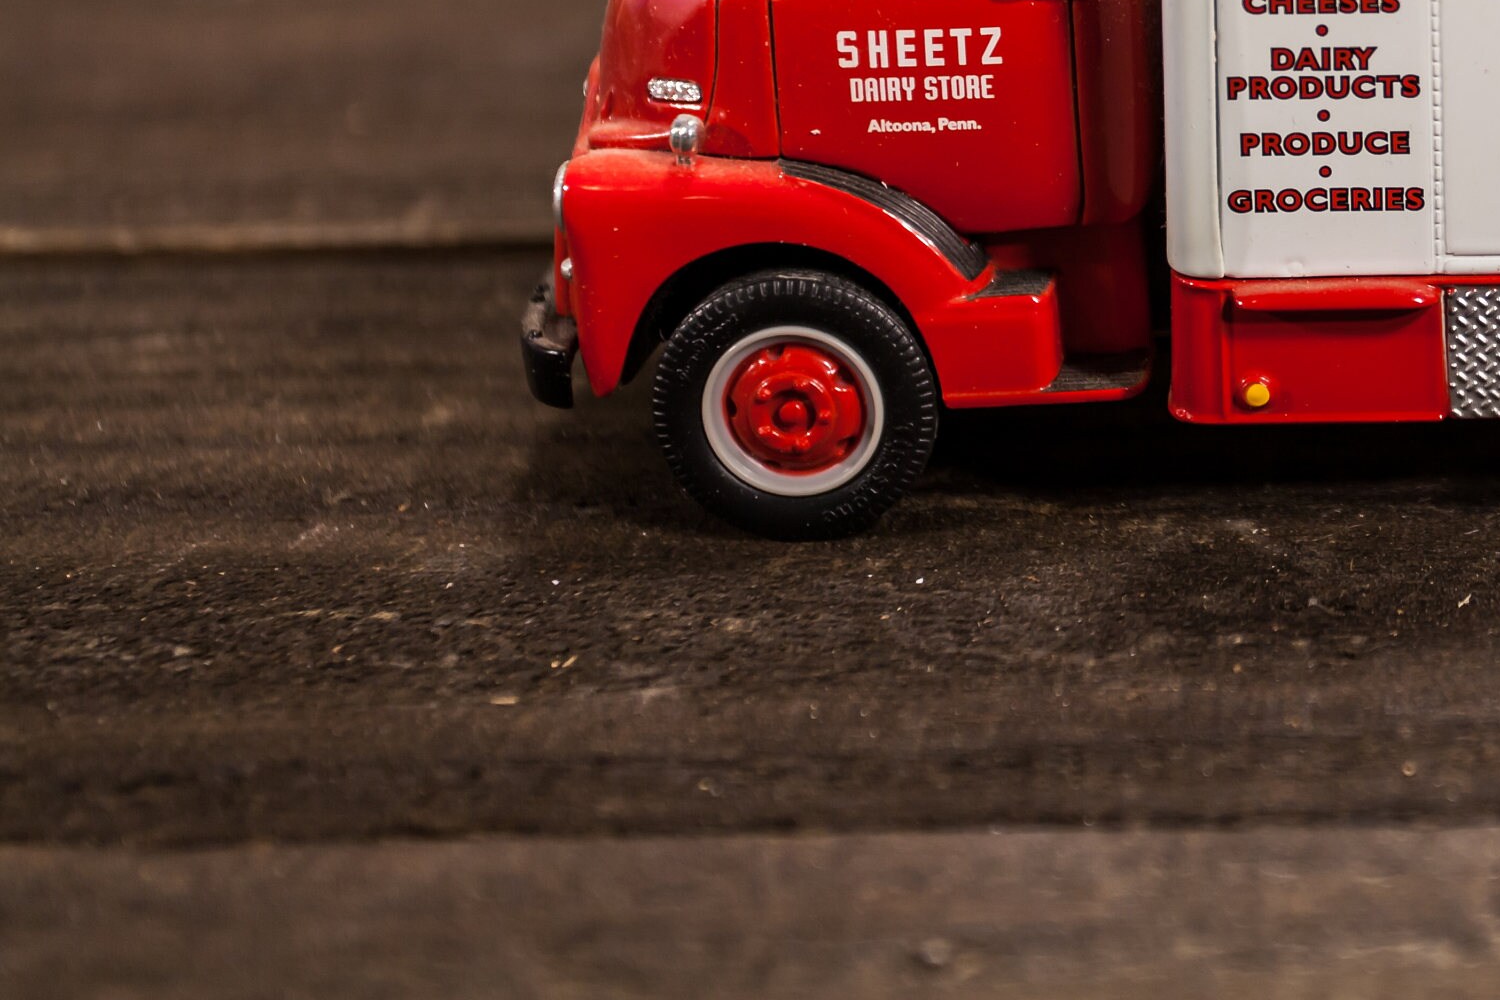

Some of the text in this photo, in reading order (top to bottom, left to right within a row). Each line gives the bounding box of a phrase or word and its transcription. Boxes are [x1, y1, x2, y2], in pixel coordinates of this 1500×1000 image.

[837, 27, 1003, 69] SHEETZ
[1270, 46, 1379, 72] DAIRY
[850, 75, 995, 103] DAIRY STORE
[1227, 74, 1421, 101] PRODUCTS
[867, 118, 982, 134] Altoona, Penn.
[1240, 131, 1411, 158] PRODUCE
[1227, 187, 1426, 214] GROCERIES
